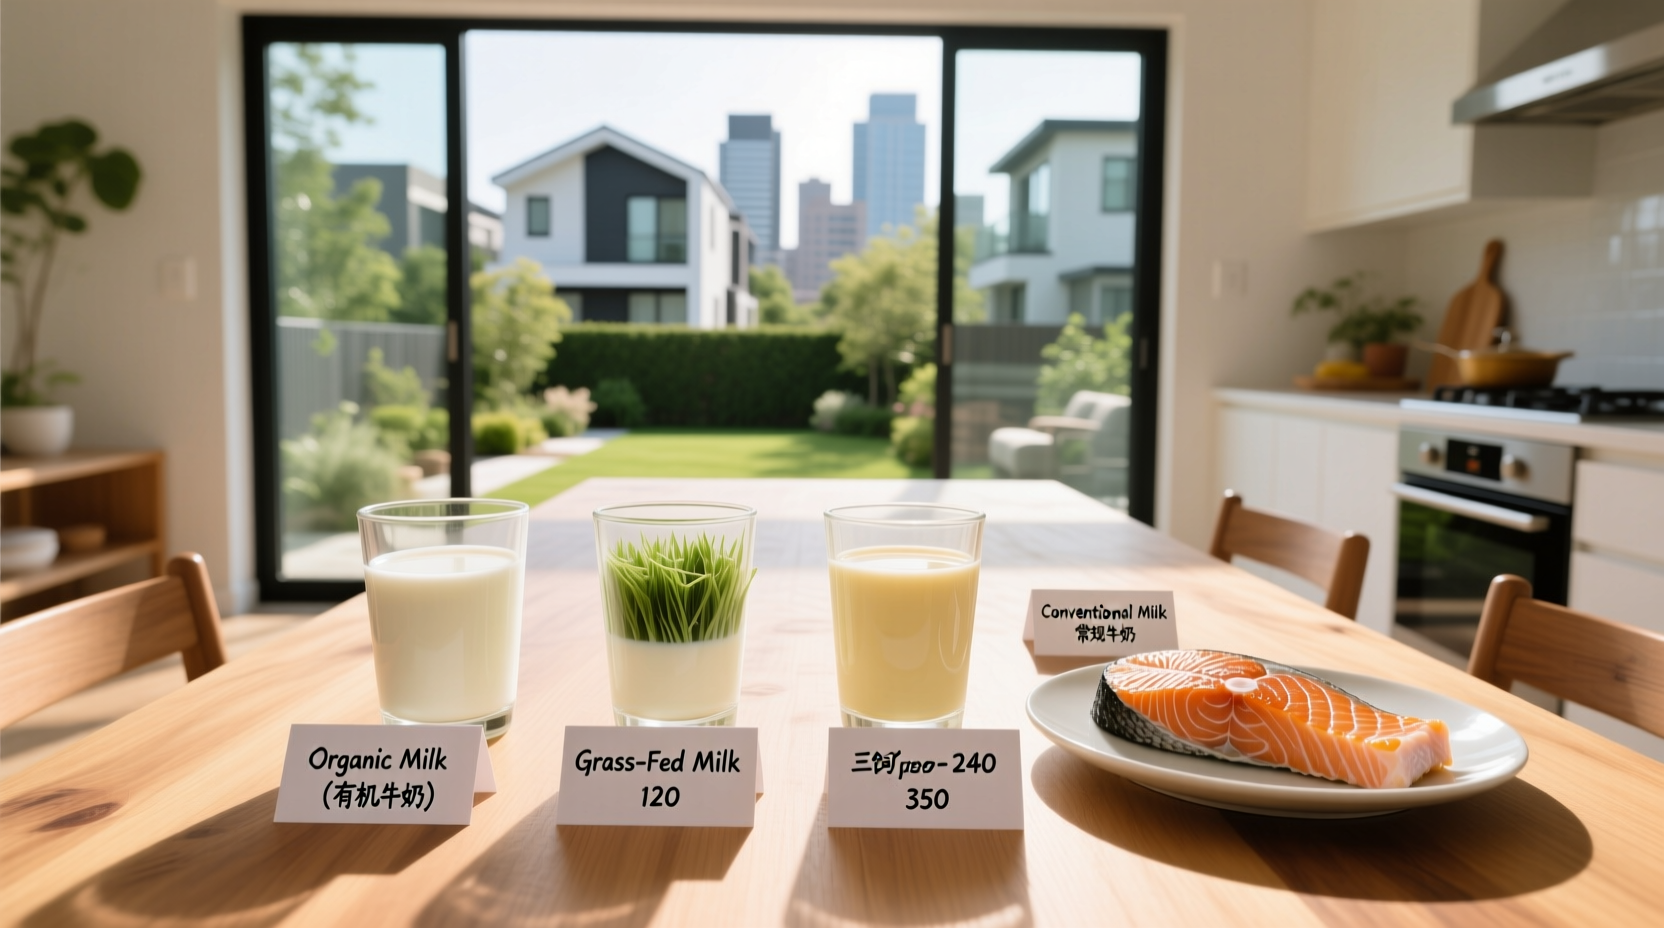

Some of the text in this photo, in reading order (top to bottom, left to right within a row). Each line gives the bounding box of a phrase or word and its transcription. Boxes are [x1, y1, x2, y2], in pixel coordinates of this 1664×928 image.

[1041, 603, 1168, 620] Conventional Milk
[1074, 623, 1136, 644] 常规牛奶
[308, 747, 447, 777] Organic Milk
[575, 748, 741, 776] Grass-Fed Milk
[323, 780, 435, 813] (有机牛奶)
[641, 785, 681, 808] 120
[905, 788, 950, 810] 350
